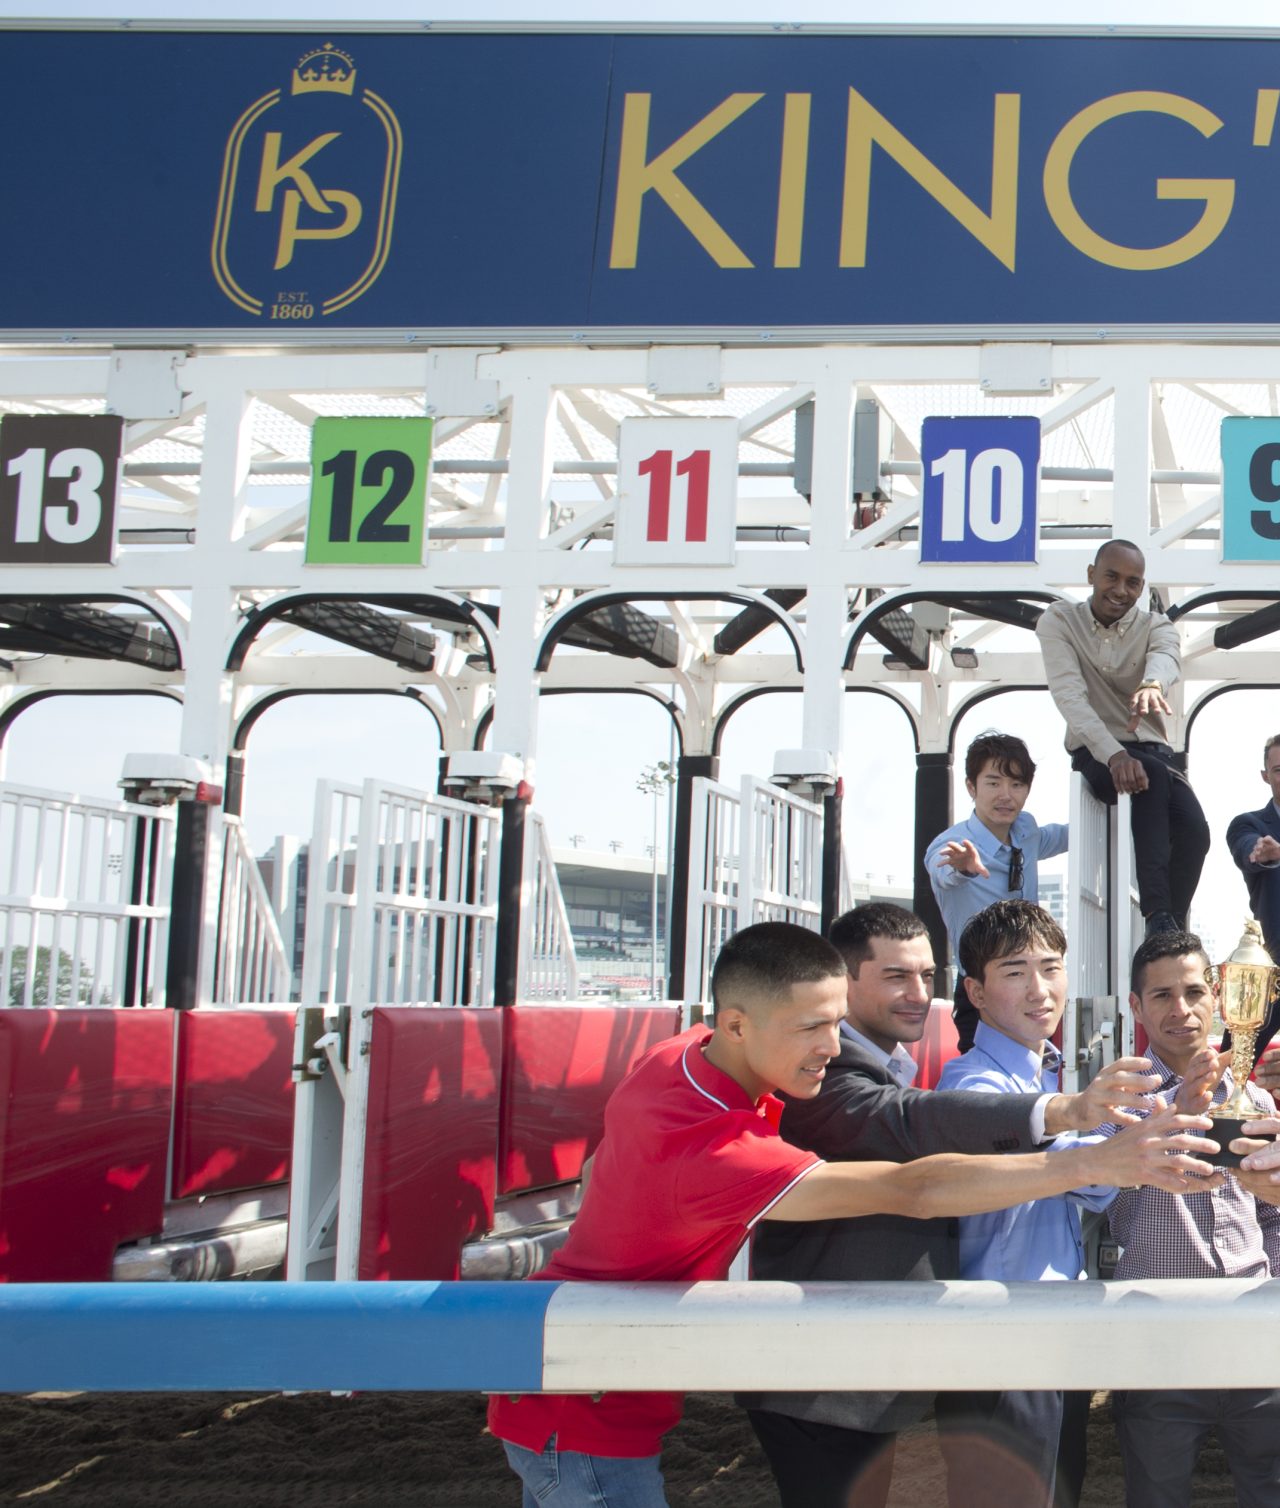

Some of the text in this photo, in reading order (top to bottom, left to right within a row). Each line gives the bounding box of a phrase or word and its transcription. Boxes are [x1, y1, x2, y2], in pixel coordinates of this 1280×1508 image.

[270, 304, 314, 319] 1860
[277, 291, 309, 303] EST.
[6, 448, 105, 544] 13
[321, 449, 415, 543] 12
[638, 449, 711, 542] 11
[930, 448, 1024, 542] 10
